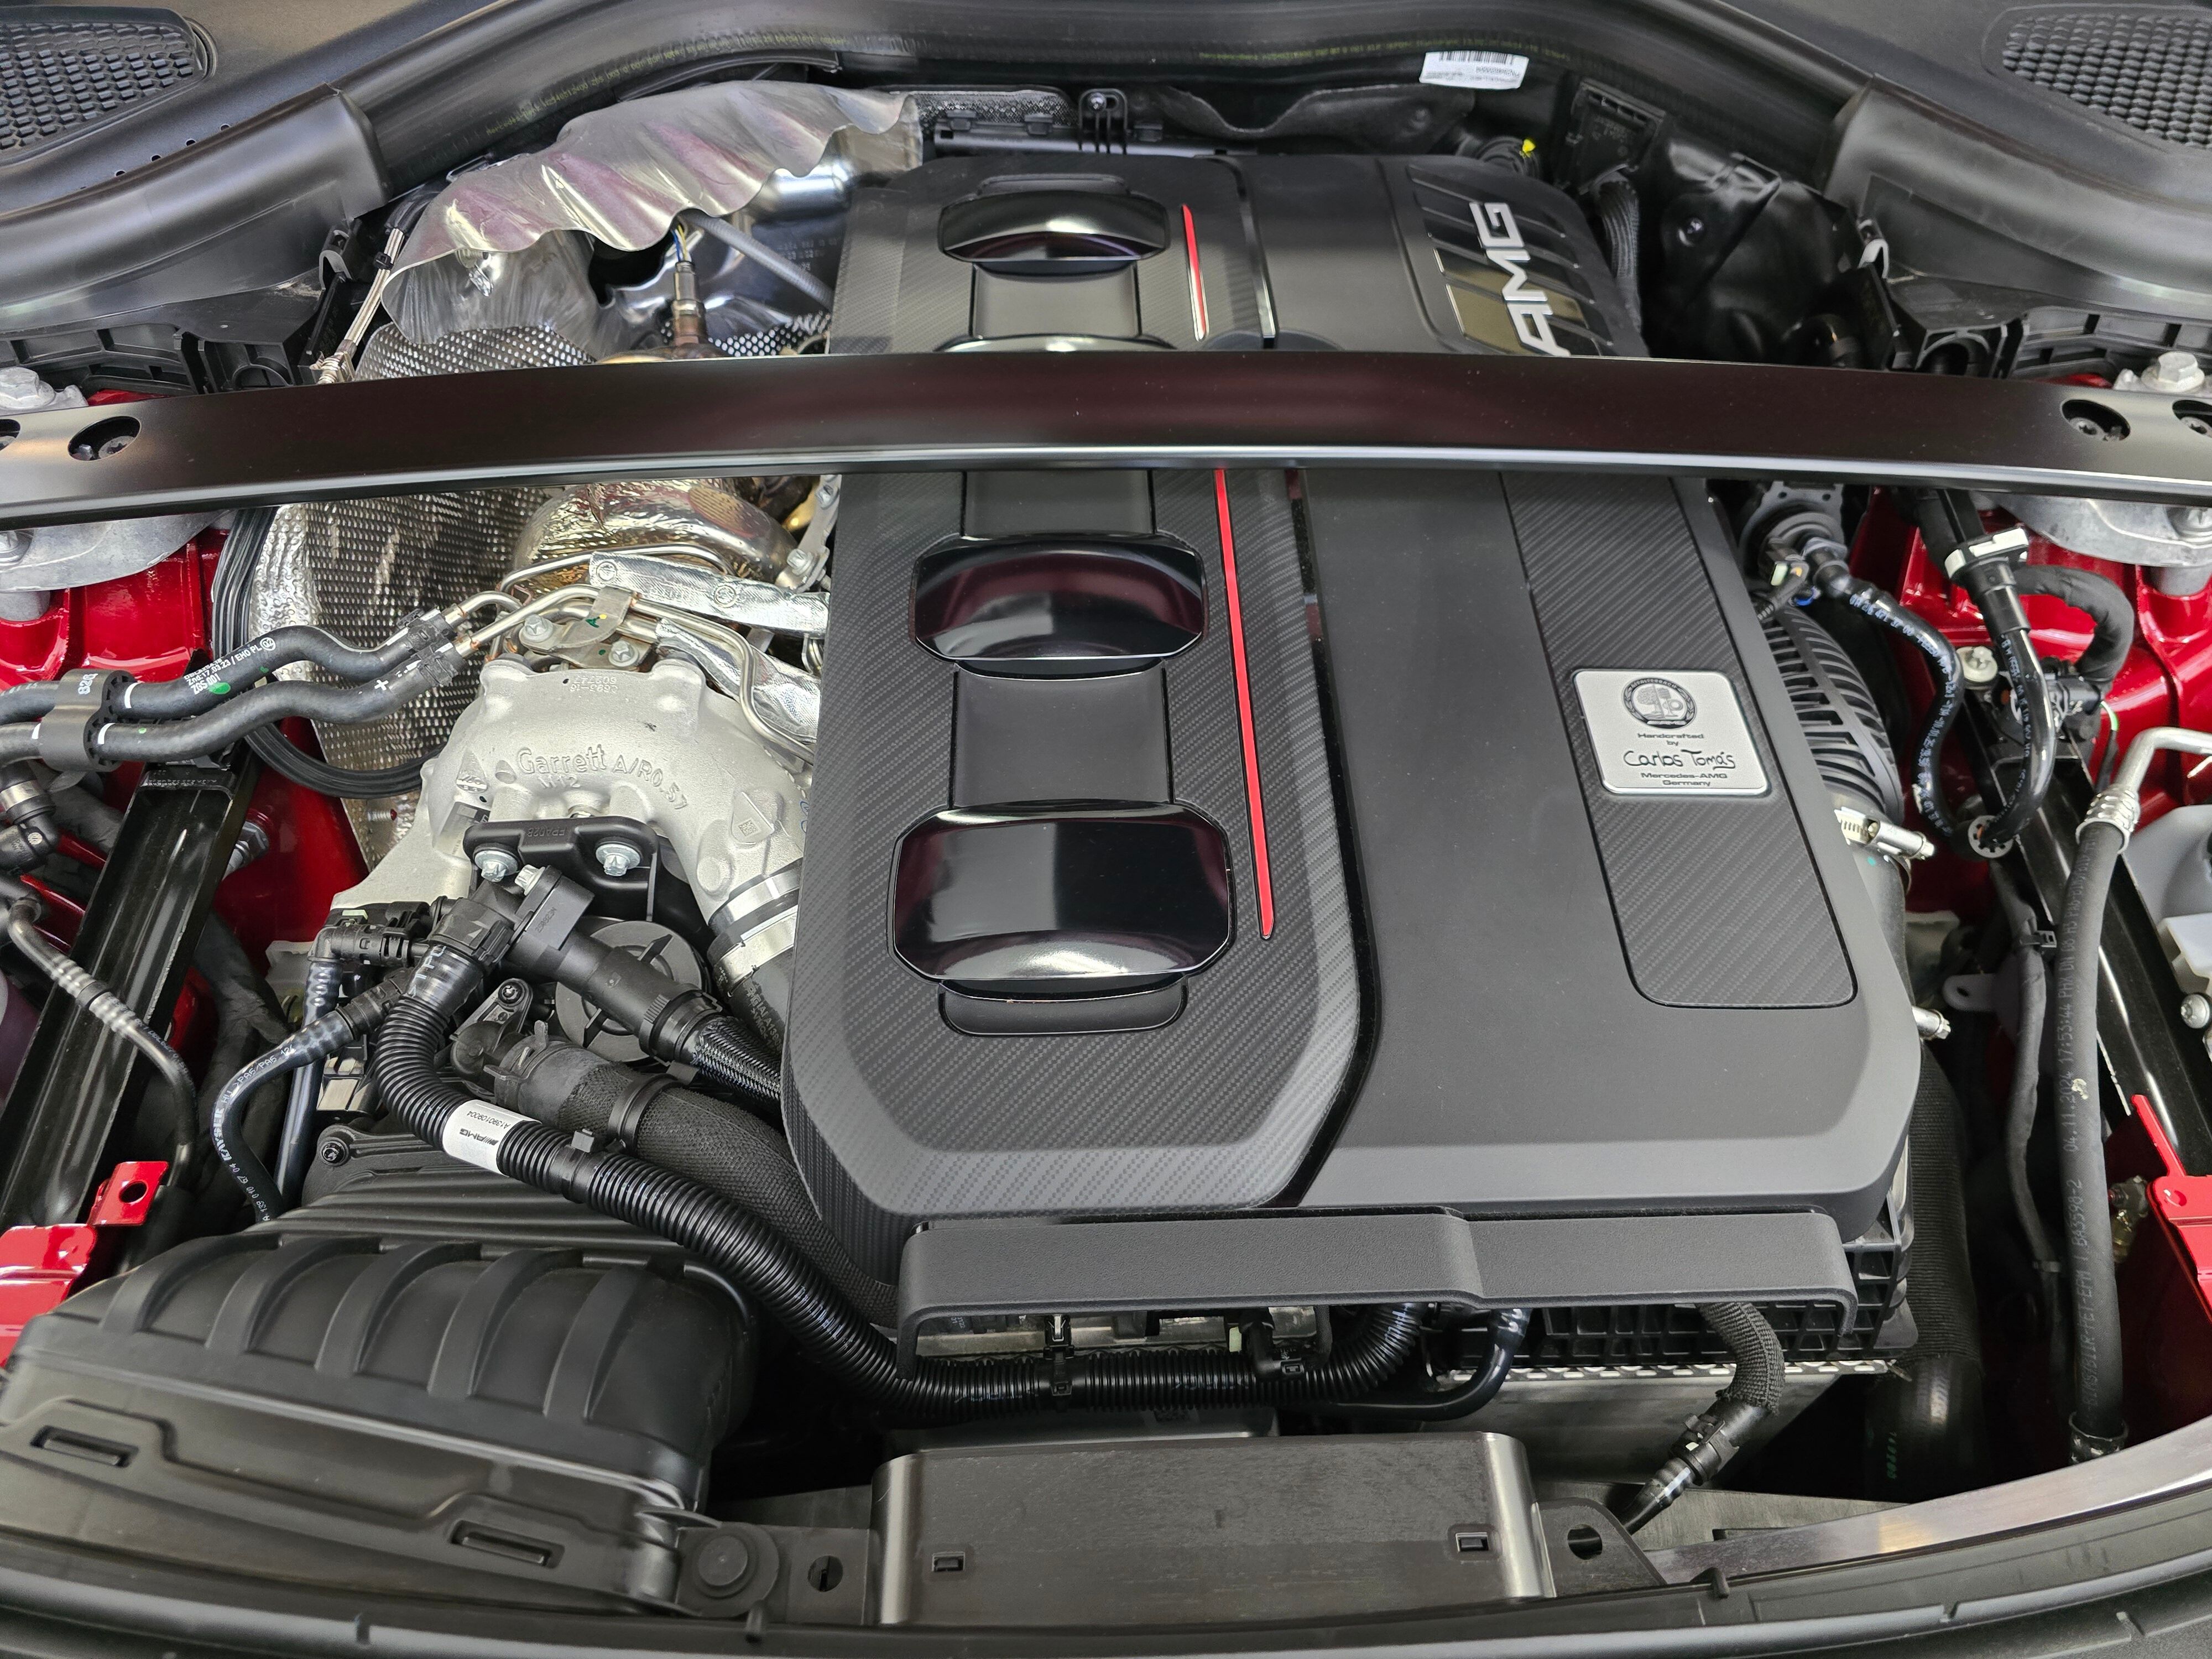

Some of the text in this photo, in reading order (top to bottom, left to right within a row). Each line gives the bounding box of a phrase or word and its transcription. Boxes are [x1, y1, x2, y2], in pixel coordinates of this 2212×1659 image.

[1469, 202, 1571, 356] AMG
[250, 644, 262, 654] PL
[190, 673, 221, 695] ZGS 001
[517, 743, 607, 774] Garrett
[1624, 749, 1736, 770] Carlos Tomás
[467, 1110, 511, 1129] A1390109004
